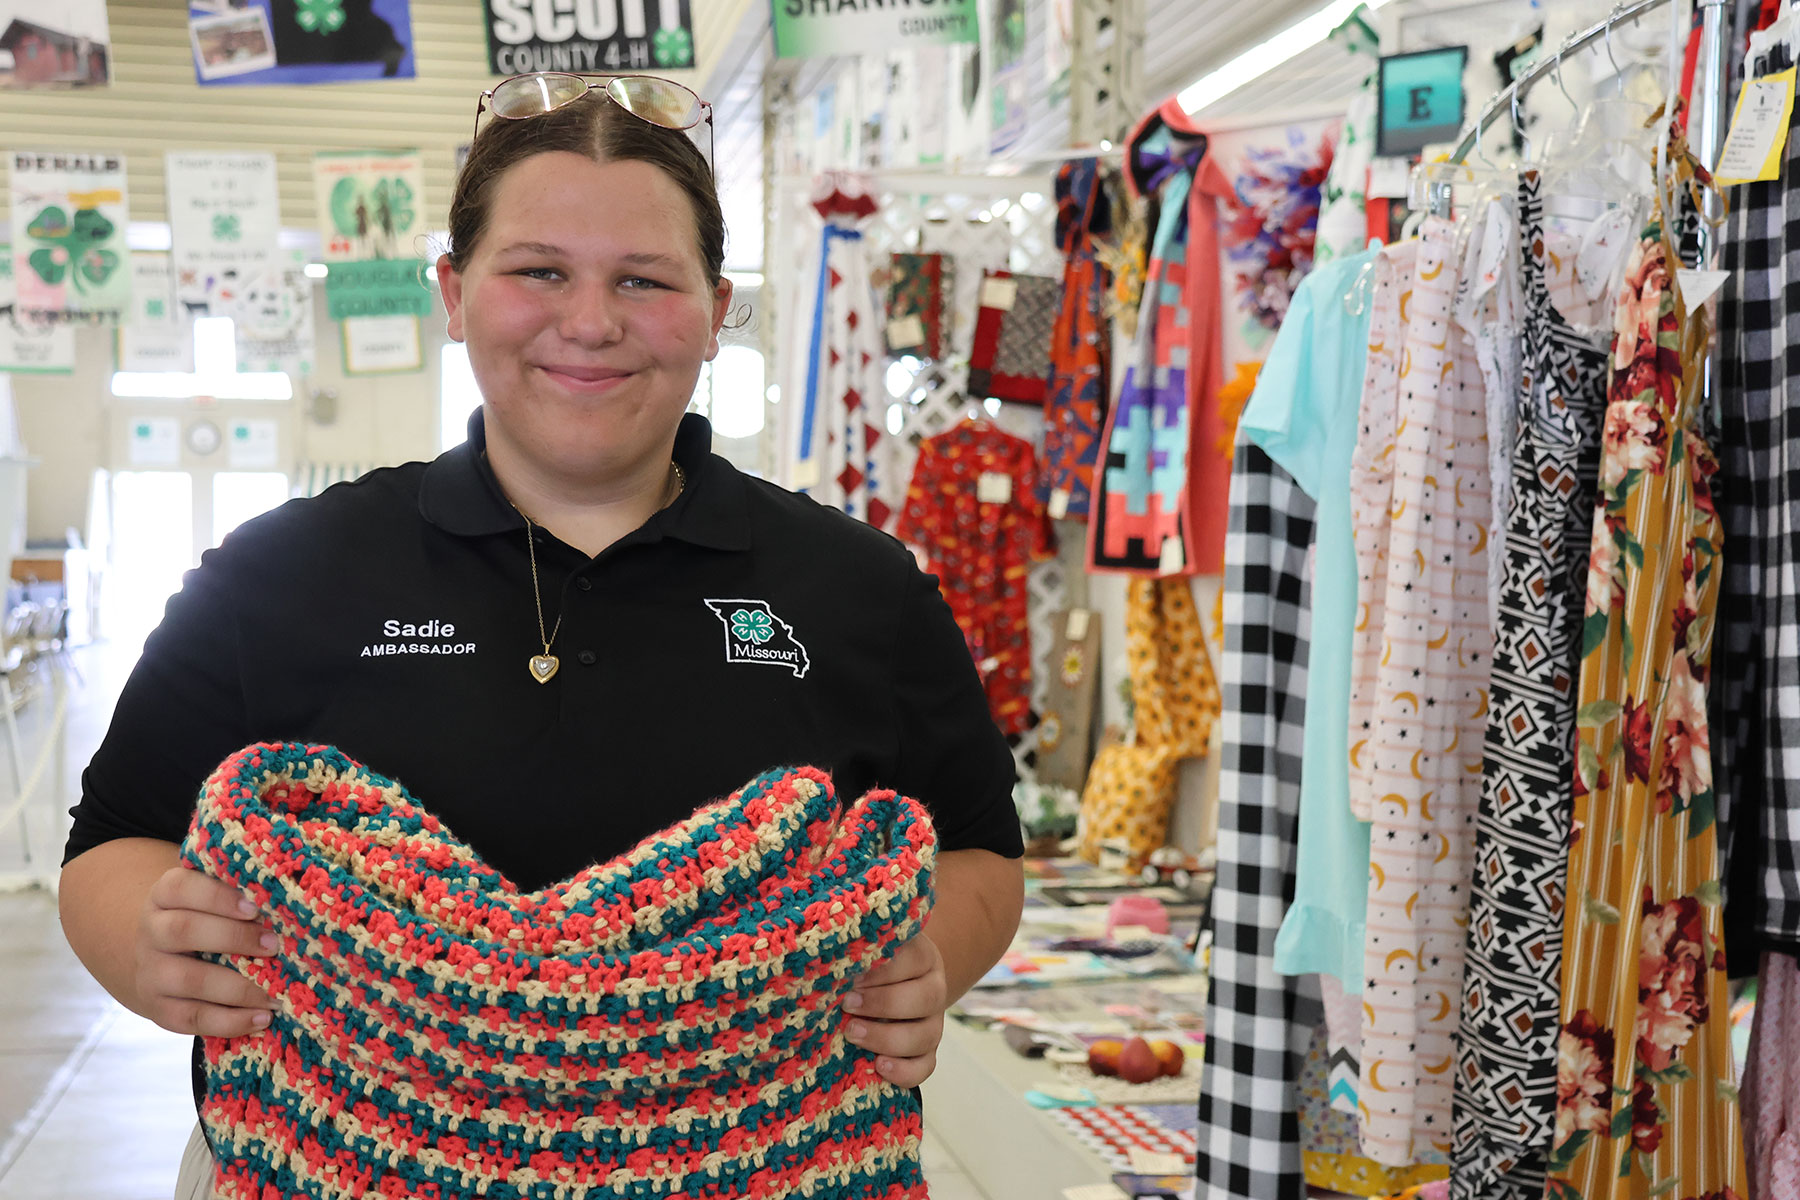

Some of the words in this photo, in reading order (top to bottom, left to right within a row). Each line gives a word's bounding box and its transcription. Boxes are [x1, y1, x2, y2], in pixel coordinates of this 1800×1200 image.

[899, 15, 968, 36] COUNTY
[497, 42, 599, 74] COUNTY
[604, 41, 649, 70] 4-H
[1408, 85, 1433, 122] E
[383, 619, 455, 638] Sadie
[360, 643, 476, 658] AMBASSADOR
[734, 643, 800, 663] Missouri
